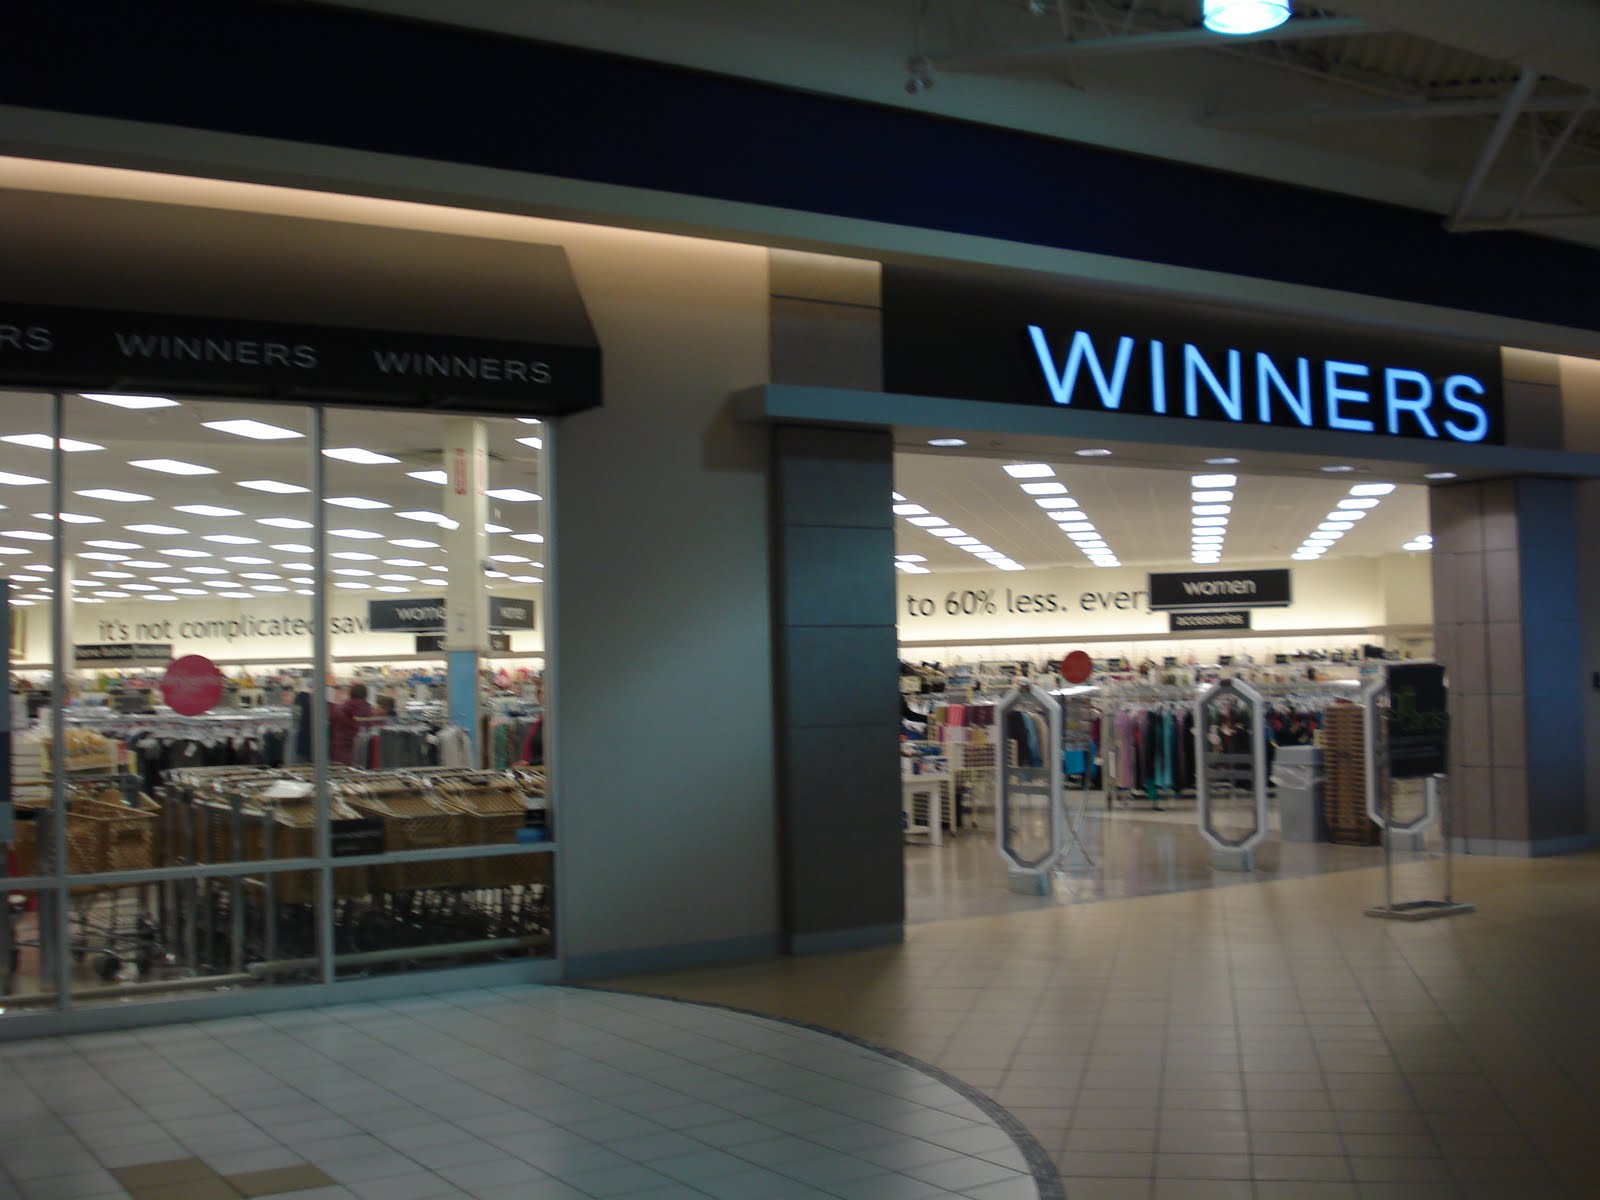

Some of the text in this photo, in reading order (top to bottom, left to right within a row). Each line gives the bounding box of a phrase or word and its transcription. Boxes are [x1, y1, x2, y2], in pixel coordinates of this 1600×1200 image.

[115, 332, 318, 368] WINNERS
[374, 350, 553, 385] WINNERS
[1026, 324, 1491, 443] WINNERS
[907, 594, 935, 616] to
[945, 589, 997, 615] 60%
[1006, 587, 1068, 613] less.
[1183, 578, 1256, 596] women
[98, 618, 131, 642] it's
[136, 616, 174, 641] not
